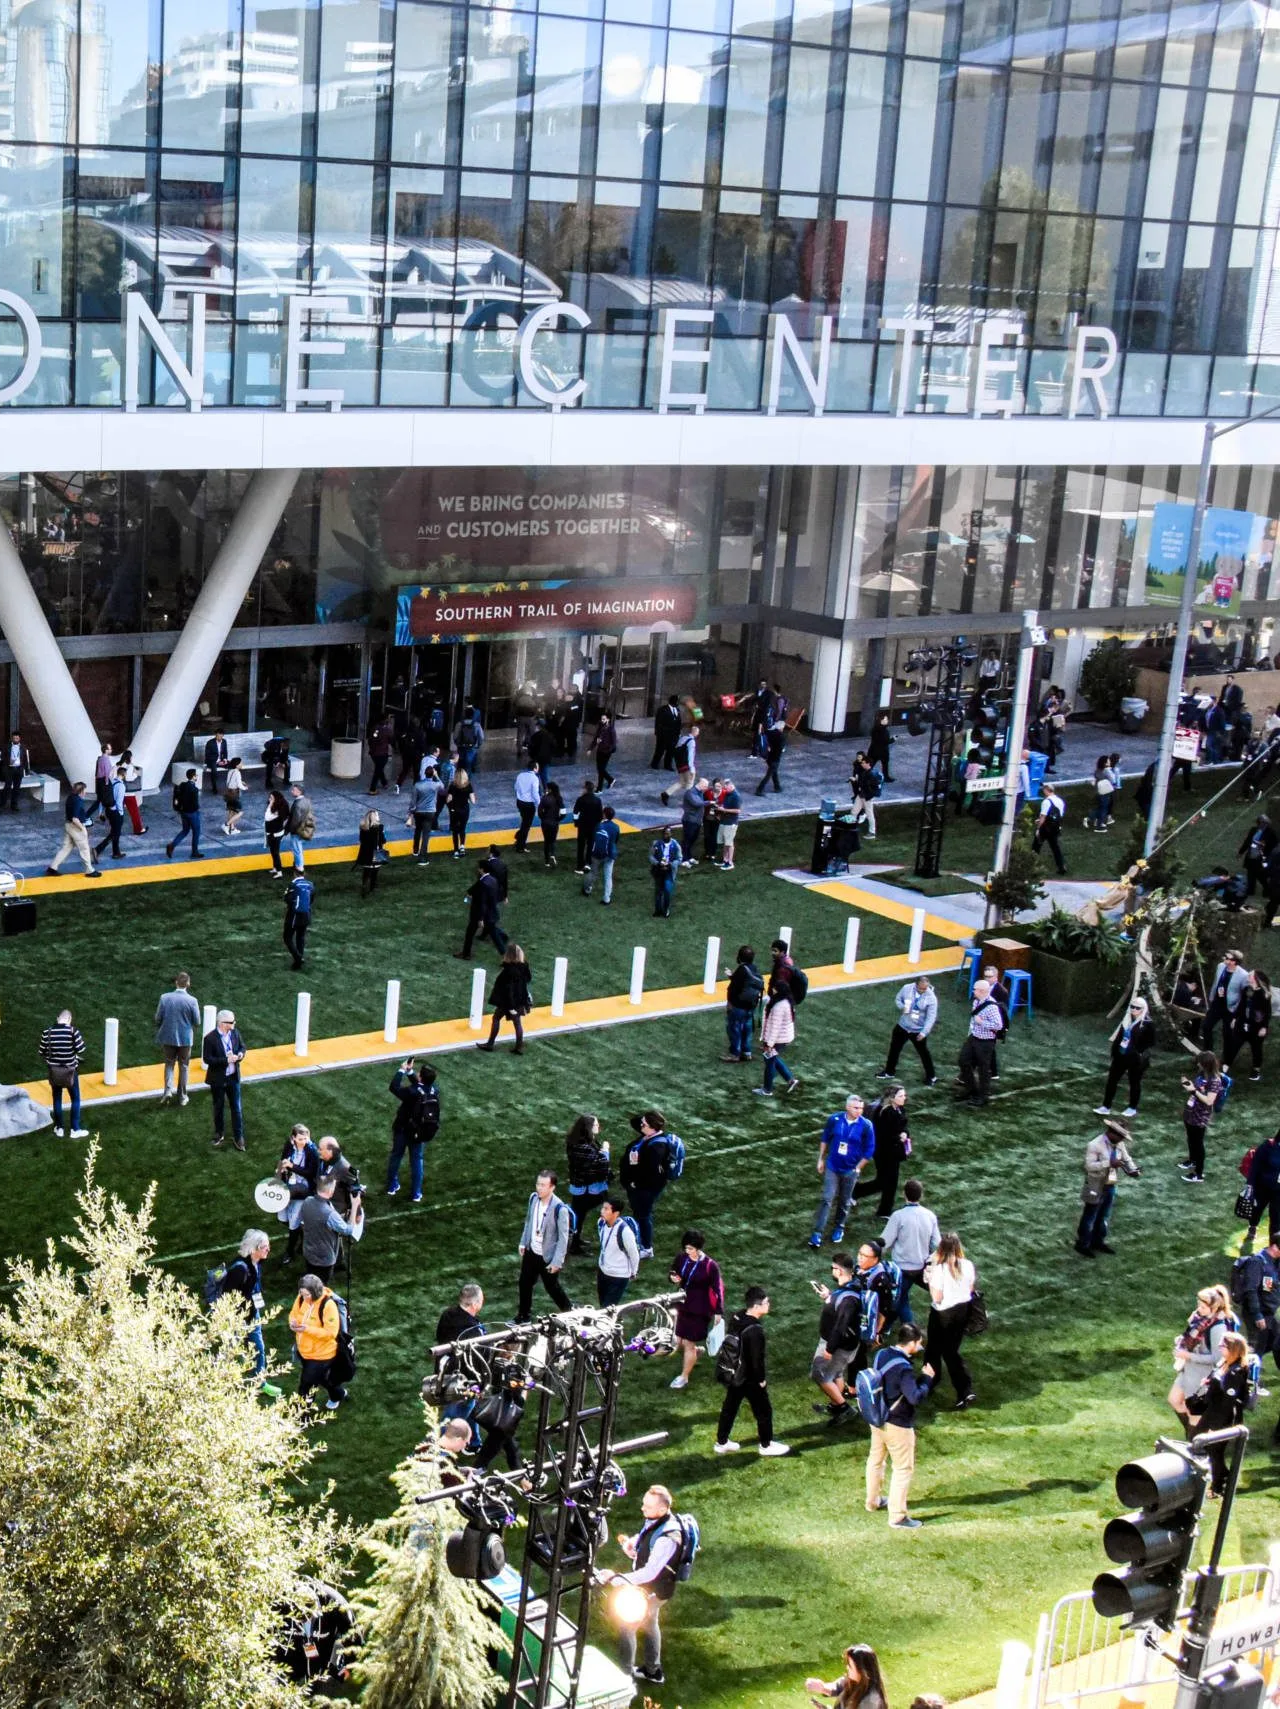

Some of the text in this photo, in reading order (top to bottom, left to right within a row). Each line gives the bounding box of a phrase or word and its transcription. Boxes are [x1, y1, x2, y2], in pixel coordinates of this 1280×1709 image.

[518, 303, 1118, 420] CENTER
[439, 491, 625, 513] WE BRING COMPANIES
[417, 517, 640, 539] AND CUSTOMERS TOGETHER
[435, 598, 675, 622] SOUTHERN TRAIL OF IMAGINATION
